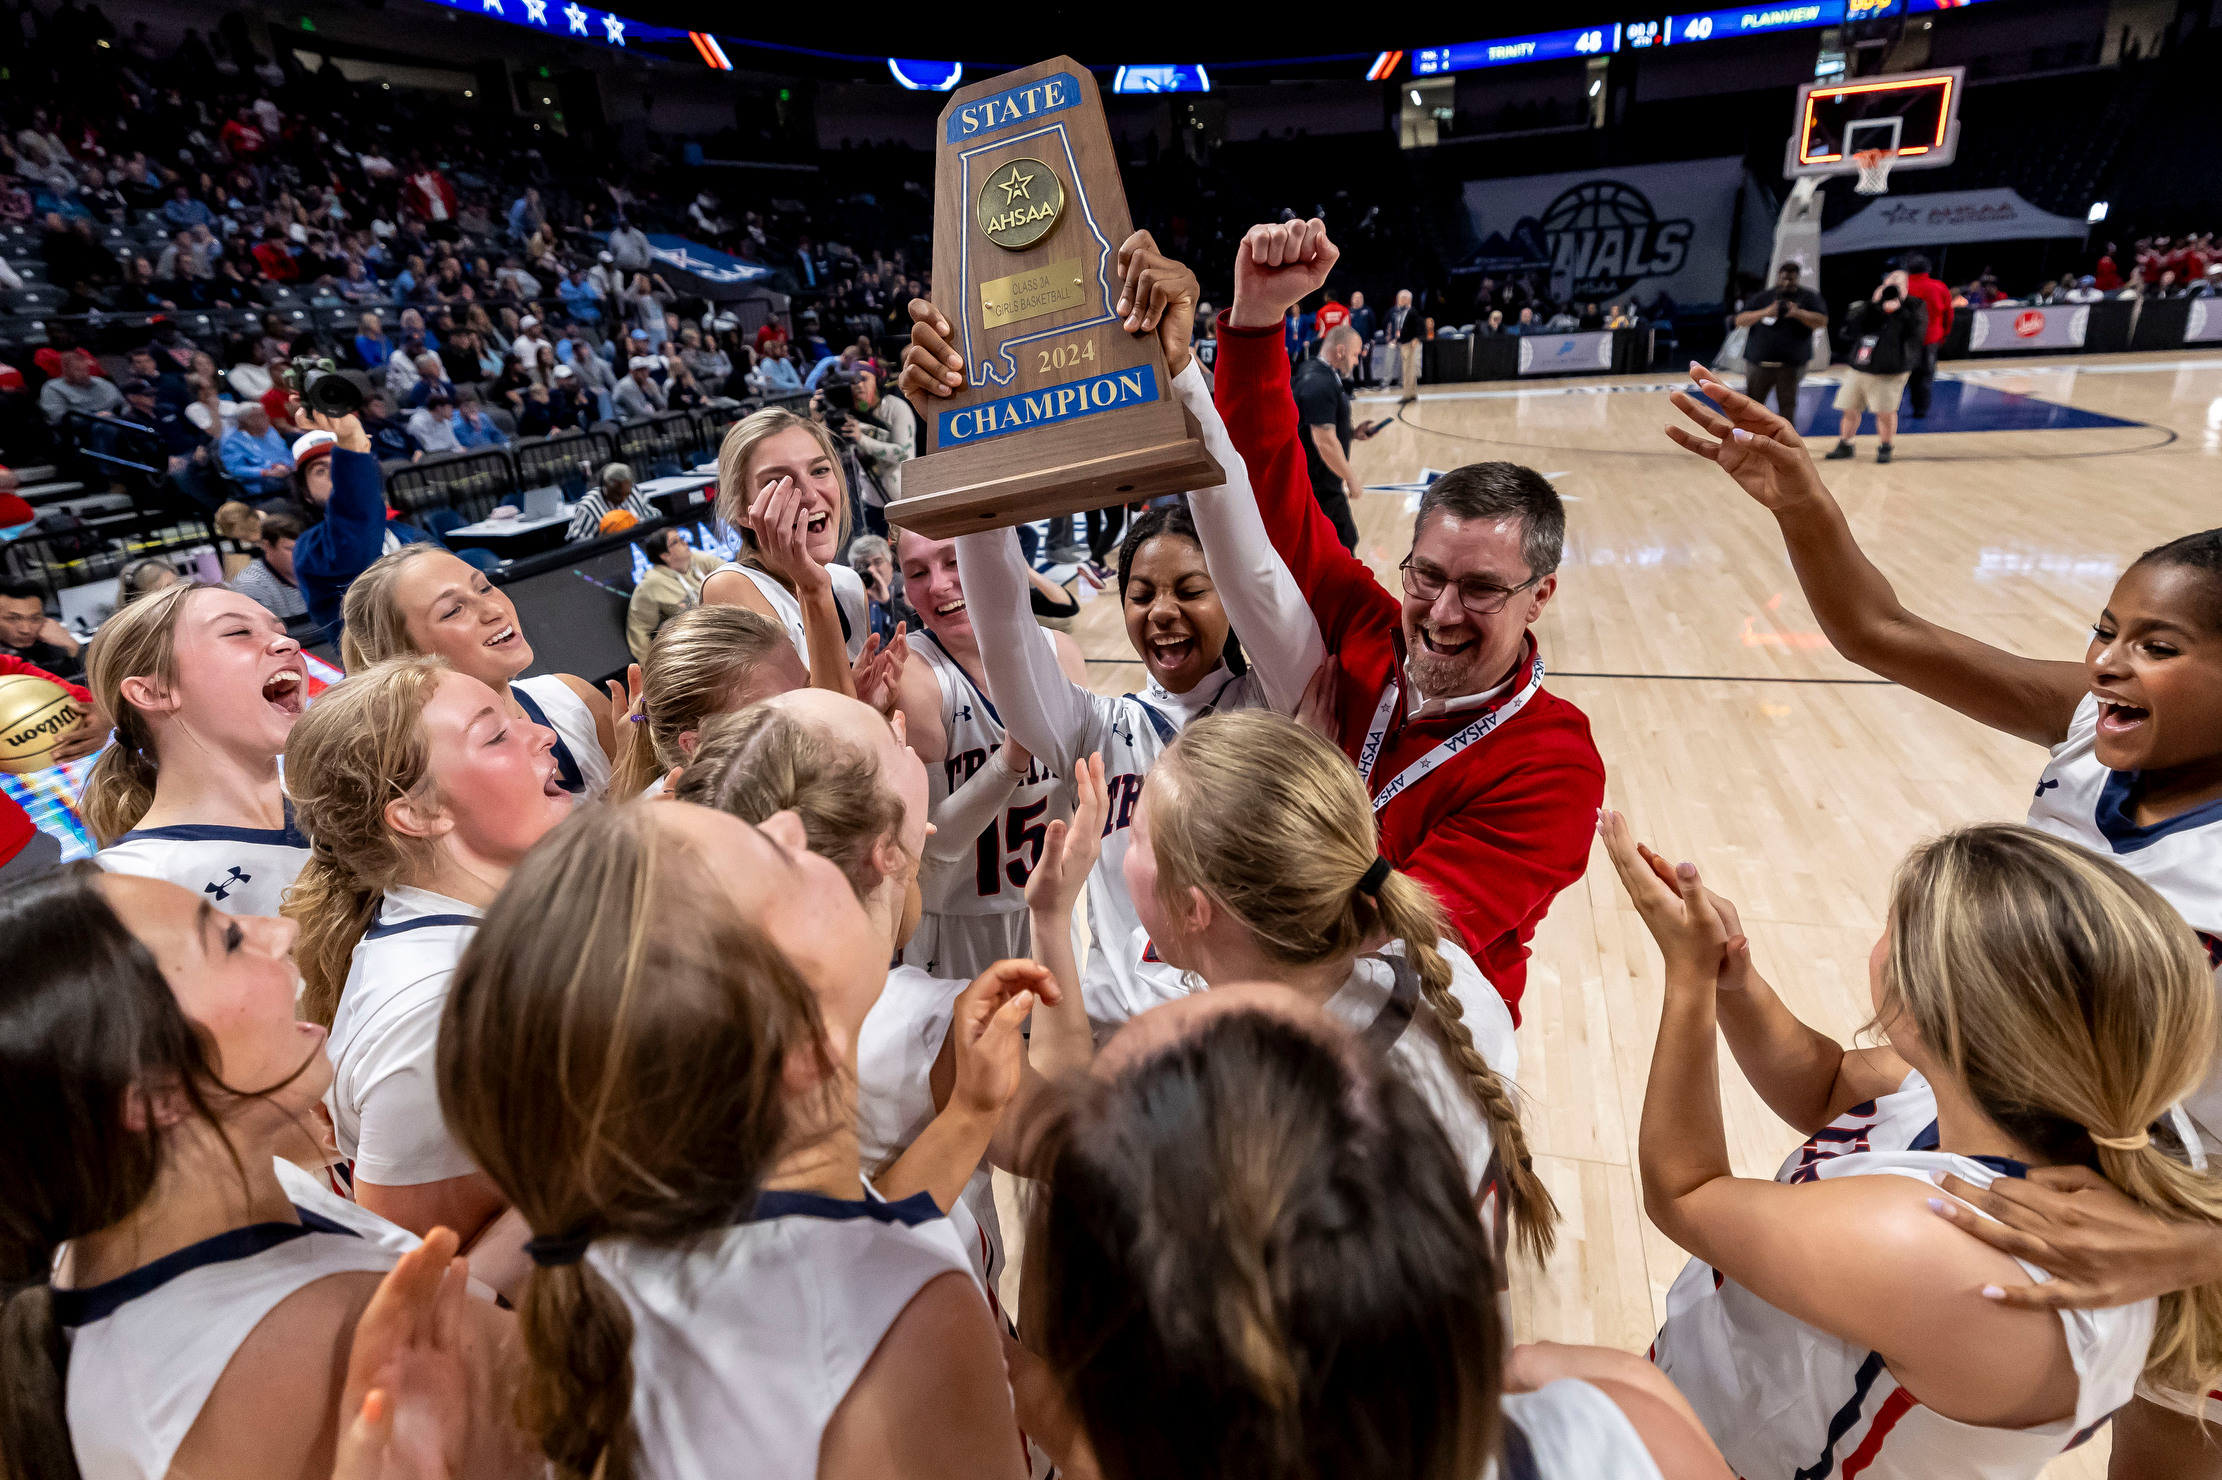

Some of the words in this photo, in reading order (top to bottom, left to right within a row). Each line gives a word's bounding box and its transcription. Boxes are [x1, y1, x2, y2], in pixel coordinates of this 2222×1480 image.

[1684, 17, 1713, 40] 40
[1741, 5, 1820, 29] PLAINVIEW
[1488, 41, 1536, 61] TRINITY
[1574, 30, 1602, 53] 48
[962, 81, 1065, 135] STATE
[987, 201, 1055, 235] AHSAA
[995, 299, 1019, 317] GIRLS
[1021, 287, 1071, 310] BASKETBALL
[1012, 278, 1038, 296] CLASS
[1040, 276, 1050, 289] 3A
[1037, 339, 1096, 374] 2024
[950, 371, 1143, 439] CHAMPION
[1444, 712, 1498, 753] AHSAA
[976, 795, 1049, 897] 15
